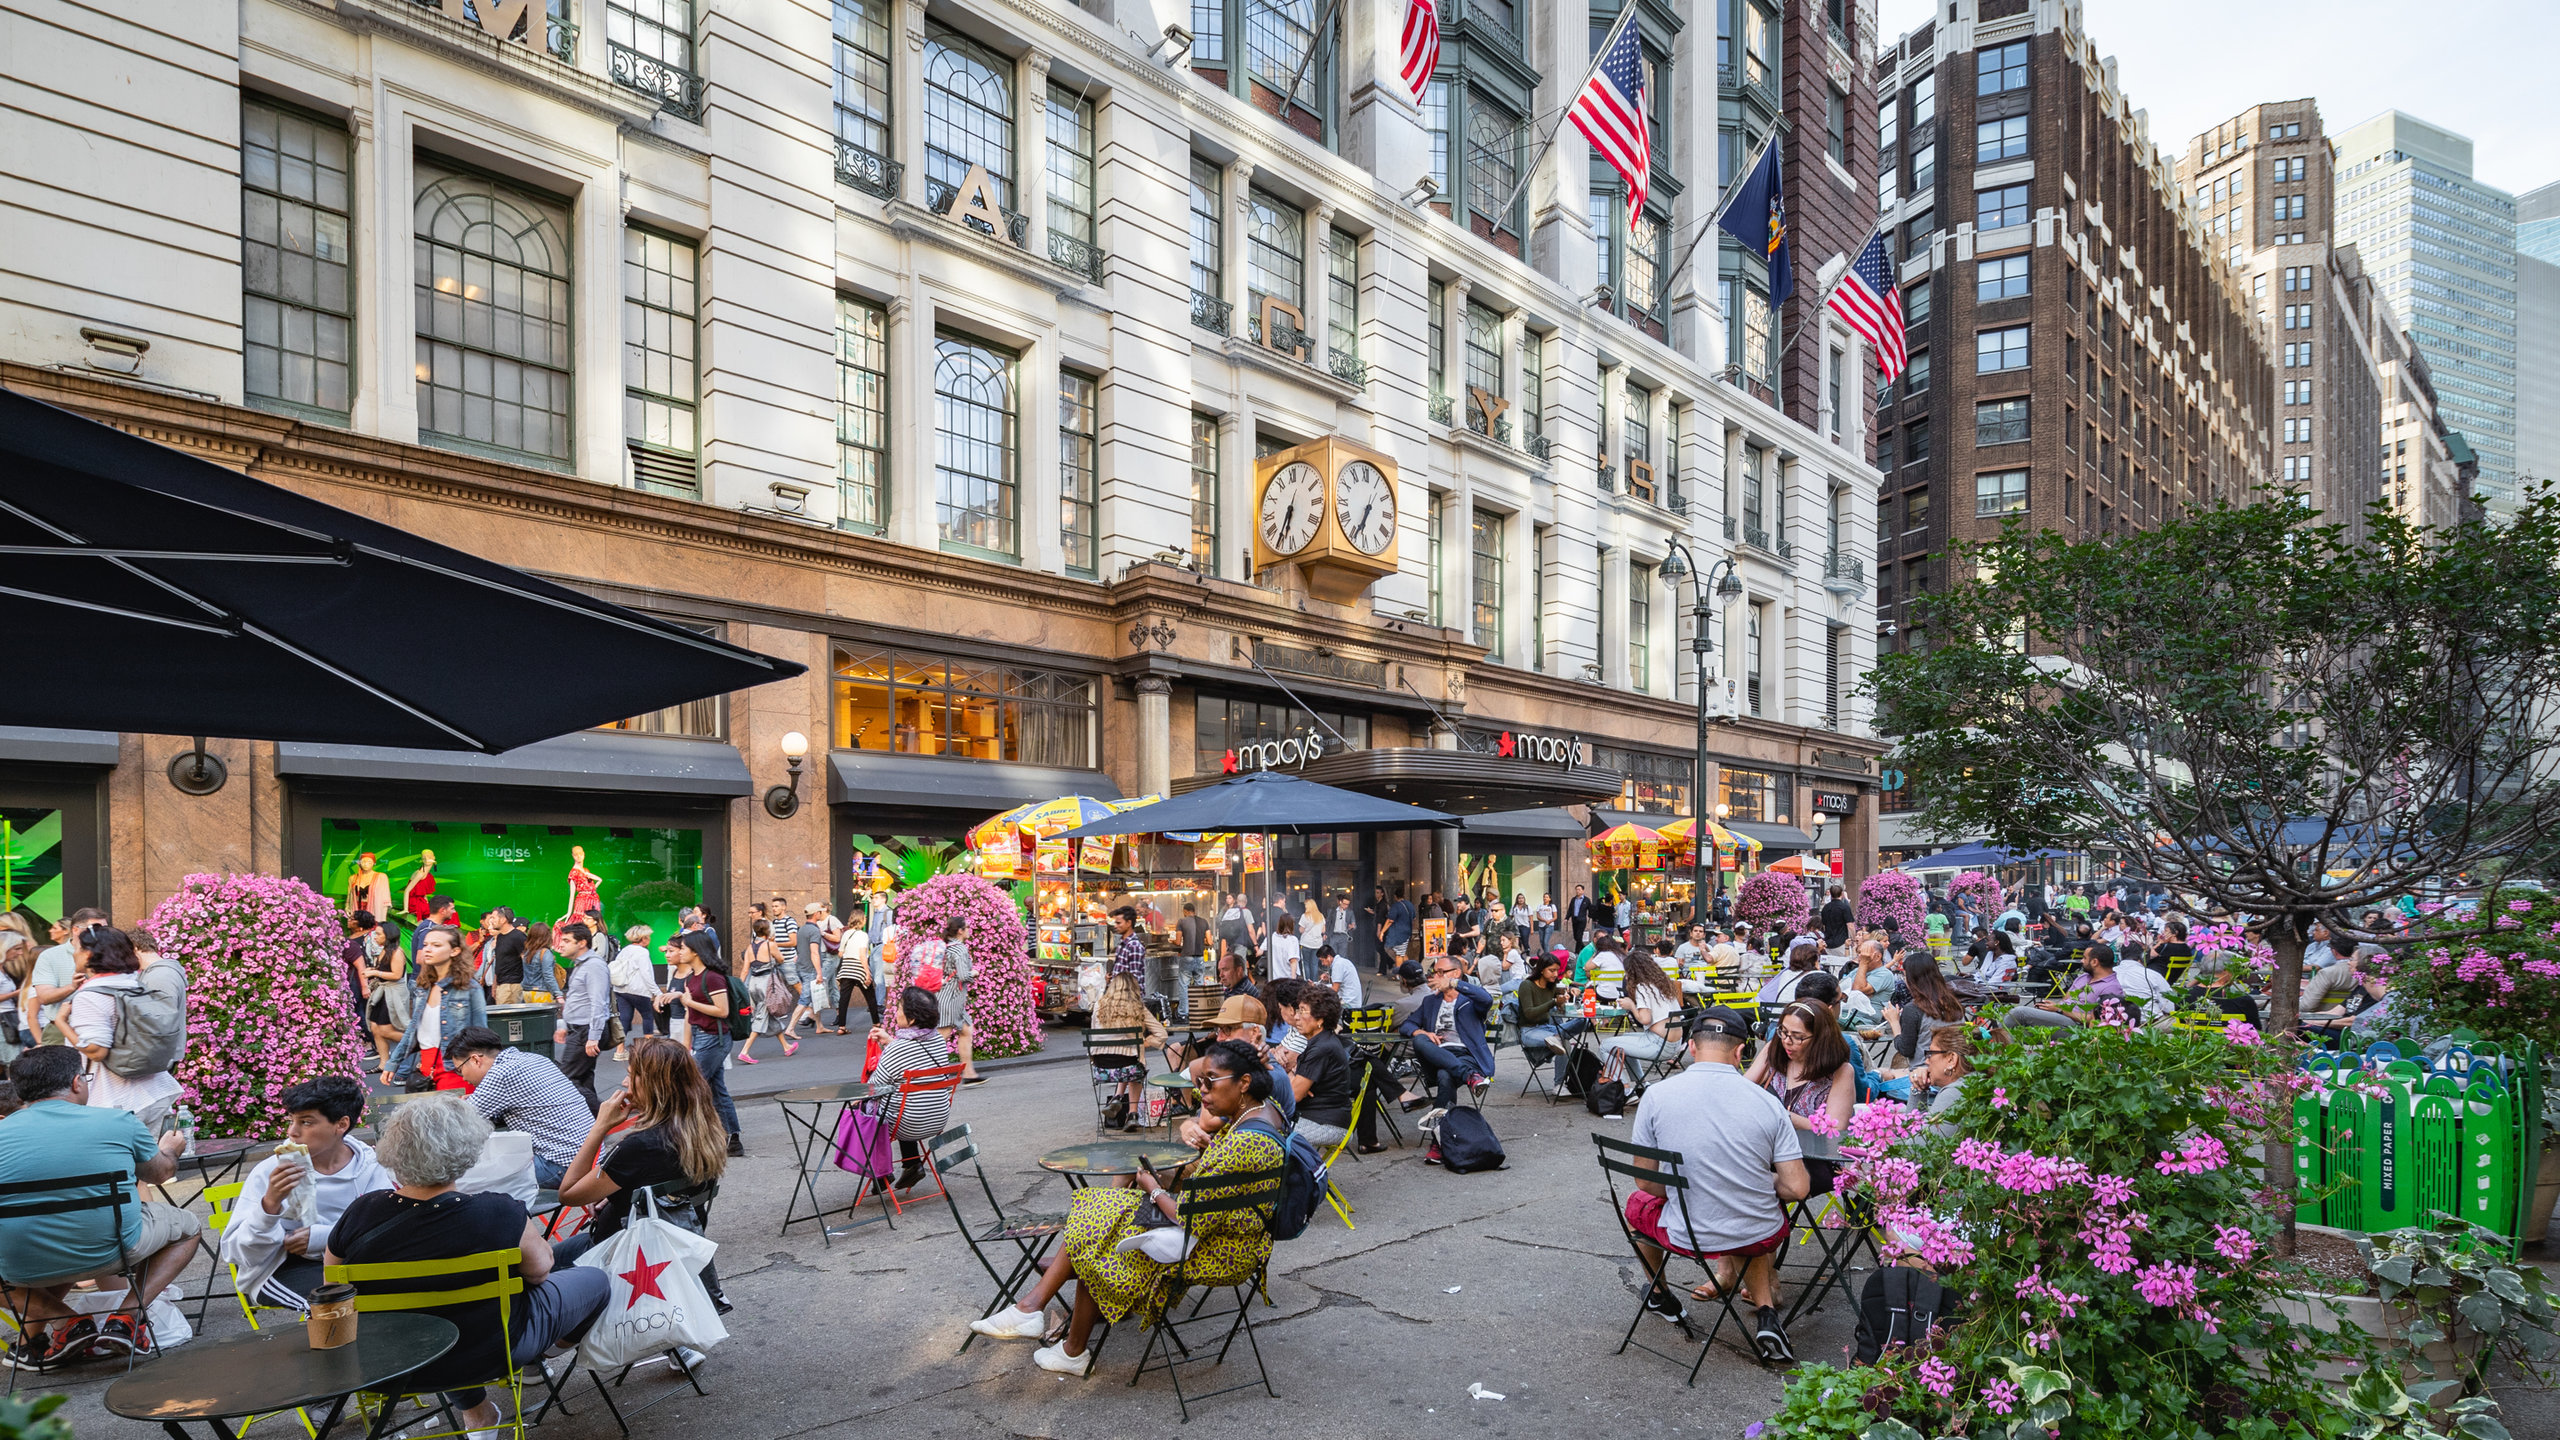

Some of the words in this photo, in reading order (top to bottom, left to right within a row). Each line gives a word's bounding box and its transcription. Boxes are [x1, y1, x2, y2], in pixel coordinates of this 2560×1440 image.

[1239, 726, 1322, 770] macy's
[1517, 733, 1583, 771] macy's
[1823, 794, 1848, 812] macy's
[2383, 1122, 2393, 1154] PAPER
[2383, 1158, 2393, 1190] MIXED
[615, 1305, 684, 1339] macy's
